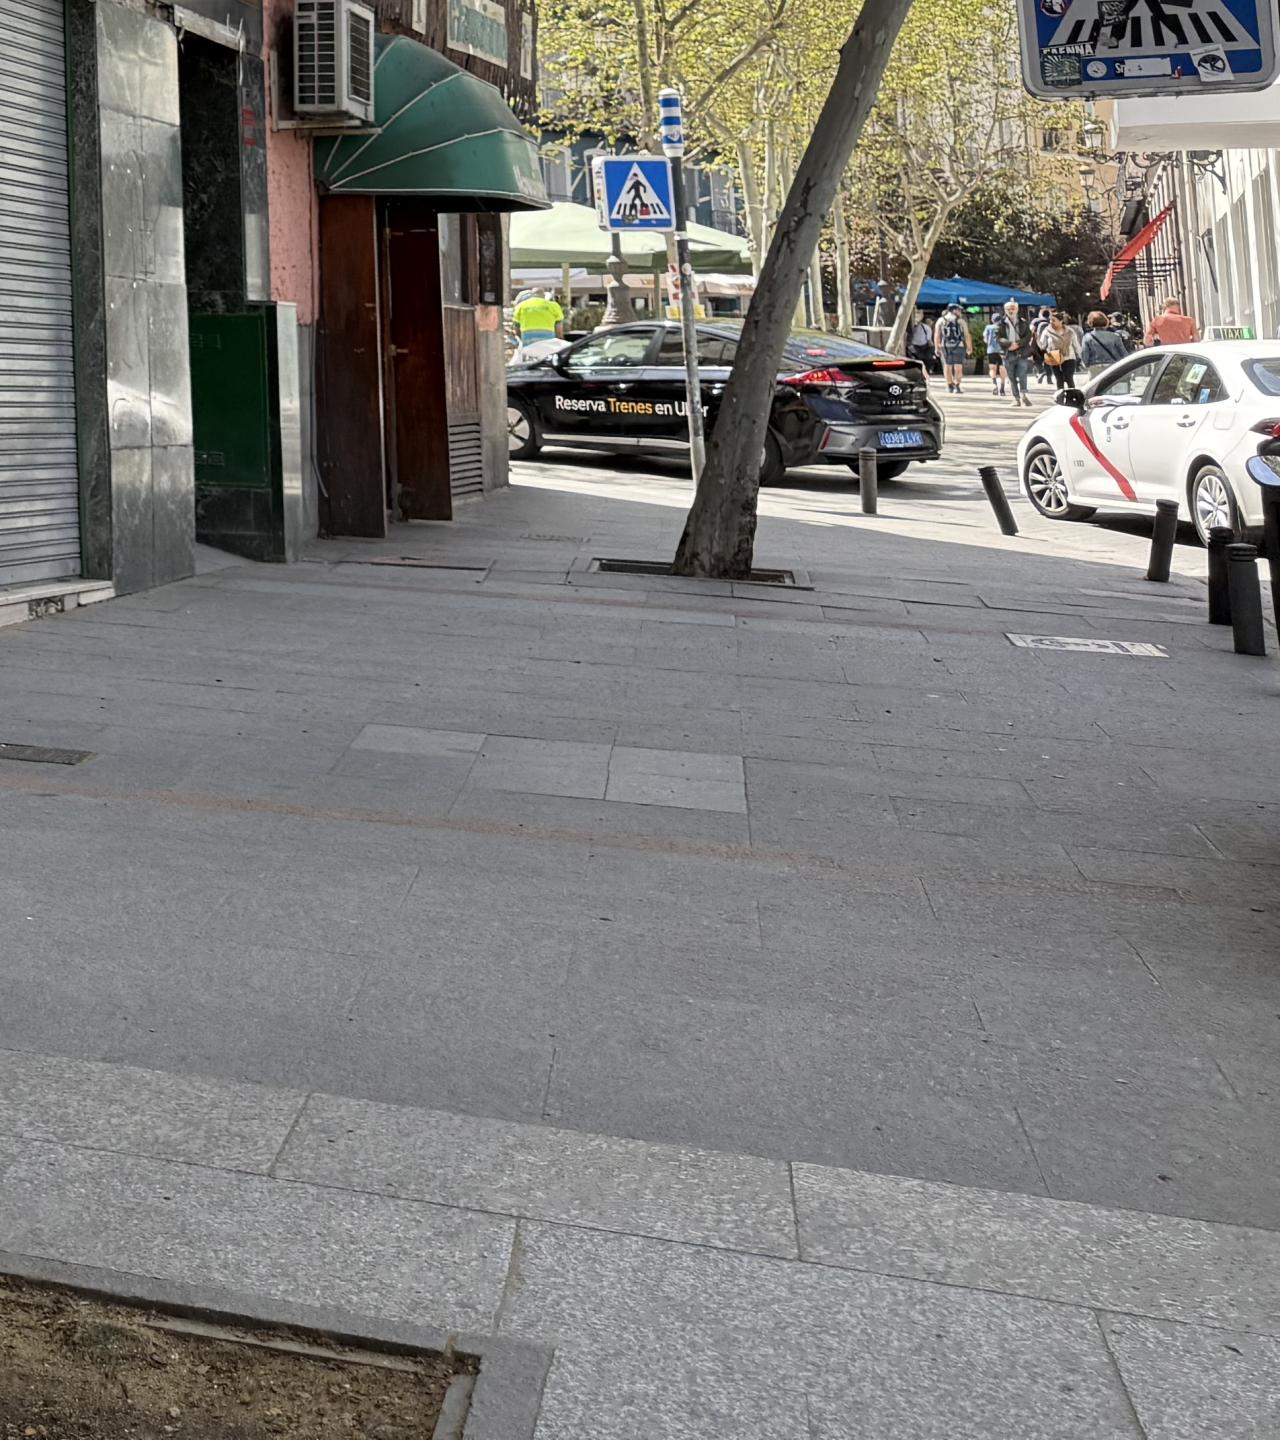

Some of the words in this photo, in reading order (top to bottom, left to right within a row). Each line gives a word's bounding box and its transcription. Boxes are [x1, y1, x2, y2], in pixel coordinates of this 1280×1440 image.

[1223, 328, 1244, 340] TAXI
[555, 395, 607, 412] Reserva
[607, 397, 653, 415] Trenes
[654, 403, 673, 416] en
